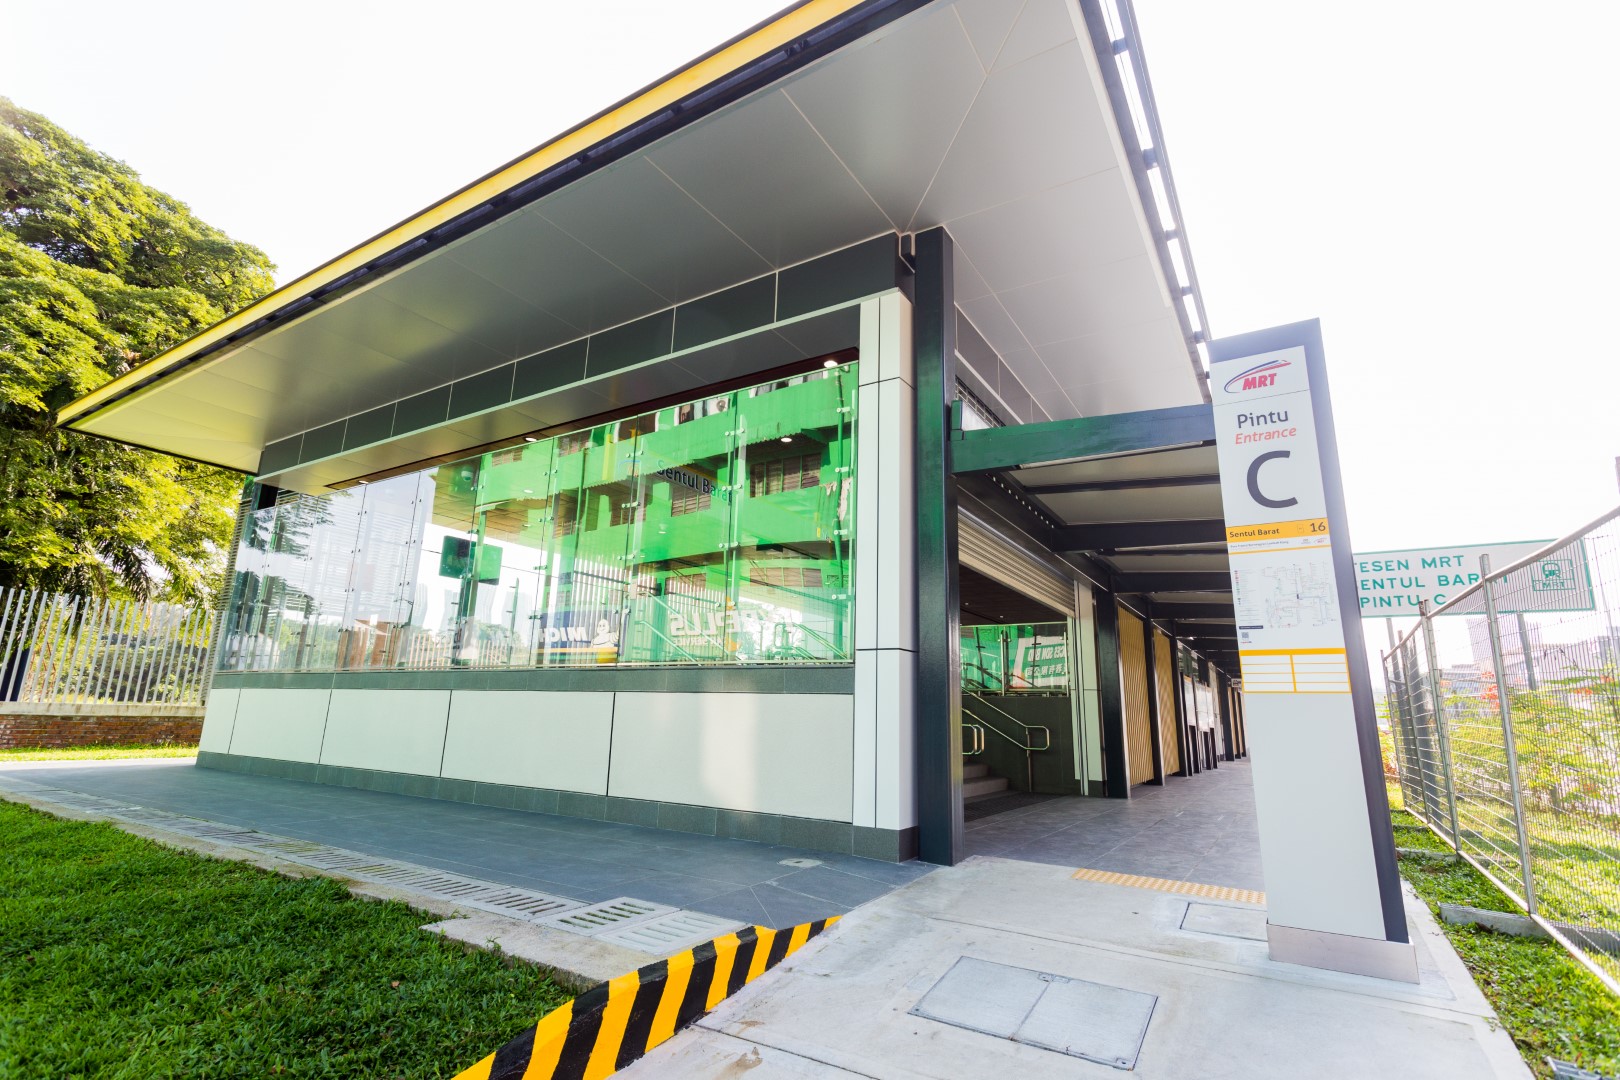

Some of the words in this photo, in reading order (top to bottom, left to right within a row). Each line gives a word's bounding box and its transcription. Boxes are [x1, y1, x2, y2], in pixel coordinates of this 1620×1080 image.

[1242, 373, 1277, 391] MRT
[1237, 410, 1289, 428] Pintu
[1235, 426, 1297, 445] Entrance
[656, 460, 699, 491] Sentul
[1247, 450, 1298, 509] C
[1229, 528, 1256, 538] Sentul
[1257, 528, 1280, 536] Barat
[1309, 521, 1326, 533] 16
[1355, 559, 1410, 573] ESEN
[1421, 555, 1465, 569] MRT
[1360, 576, 1426, 591] ENTUL
[1437, 573, 1508, 587] BAR
[1360, 594, 1420, 608] PINTU
[1433, 593, 1447, 605] C
